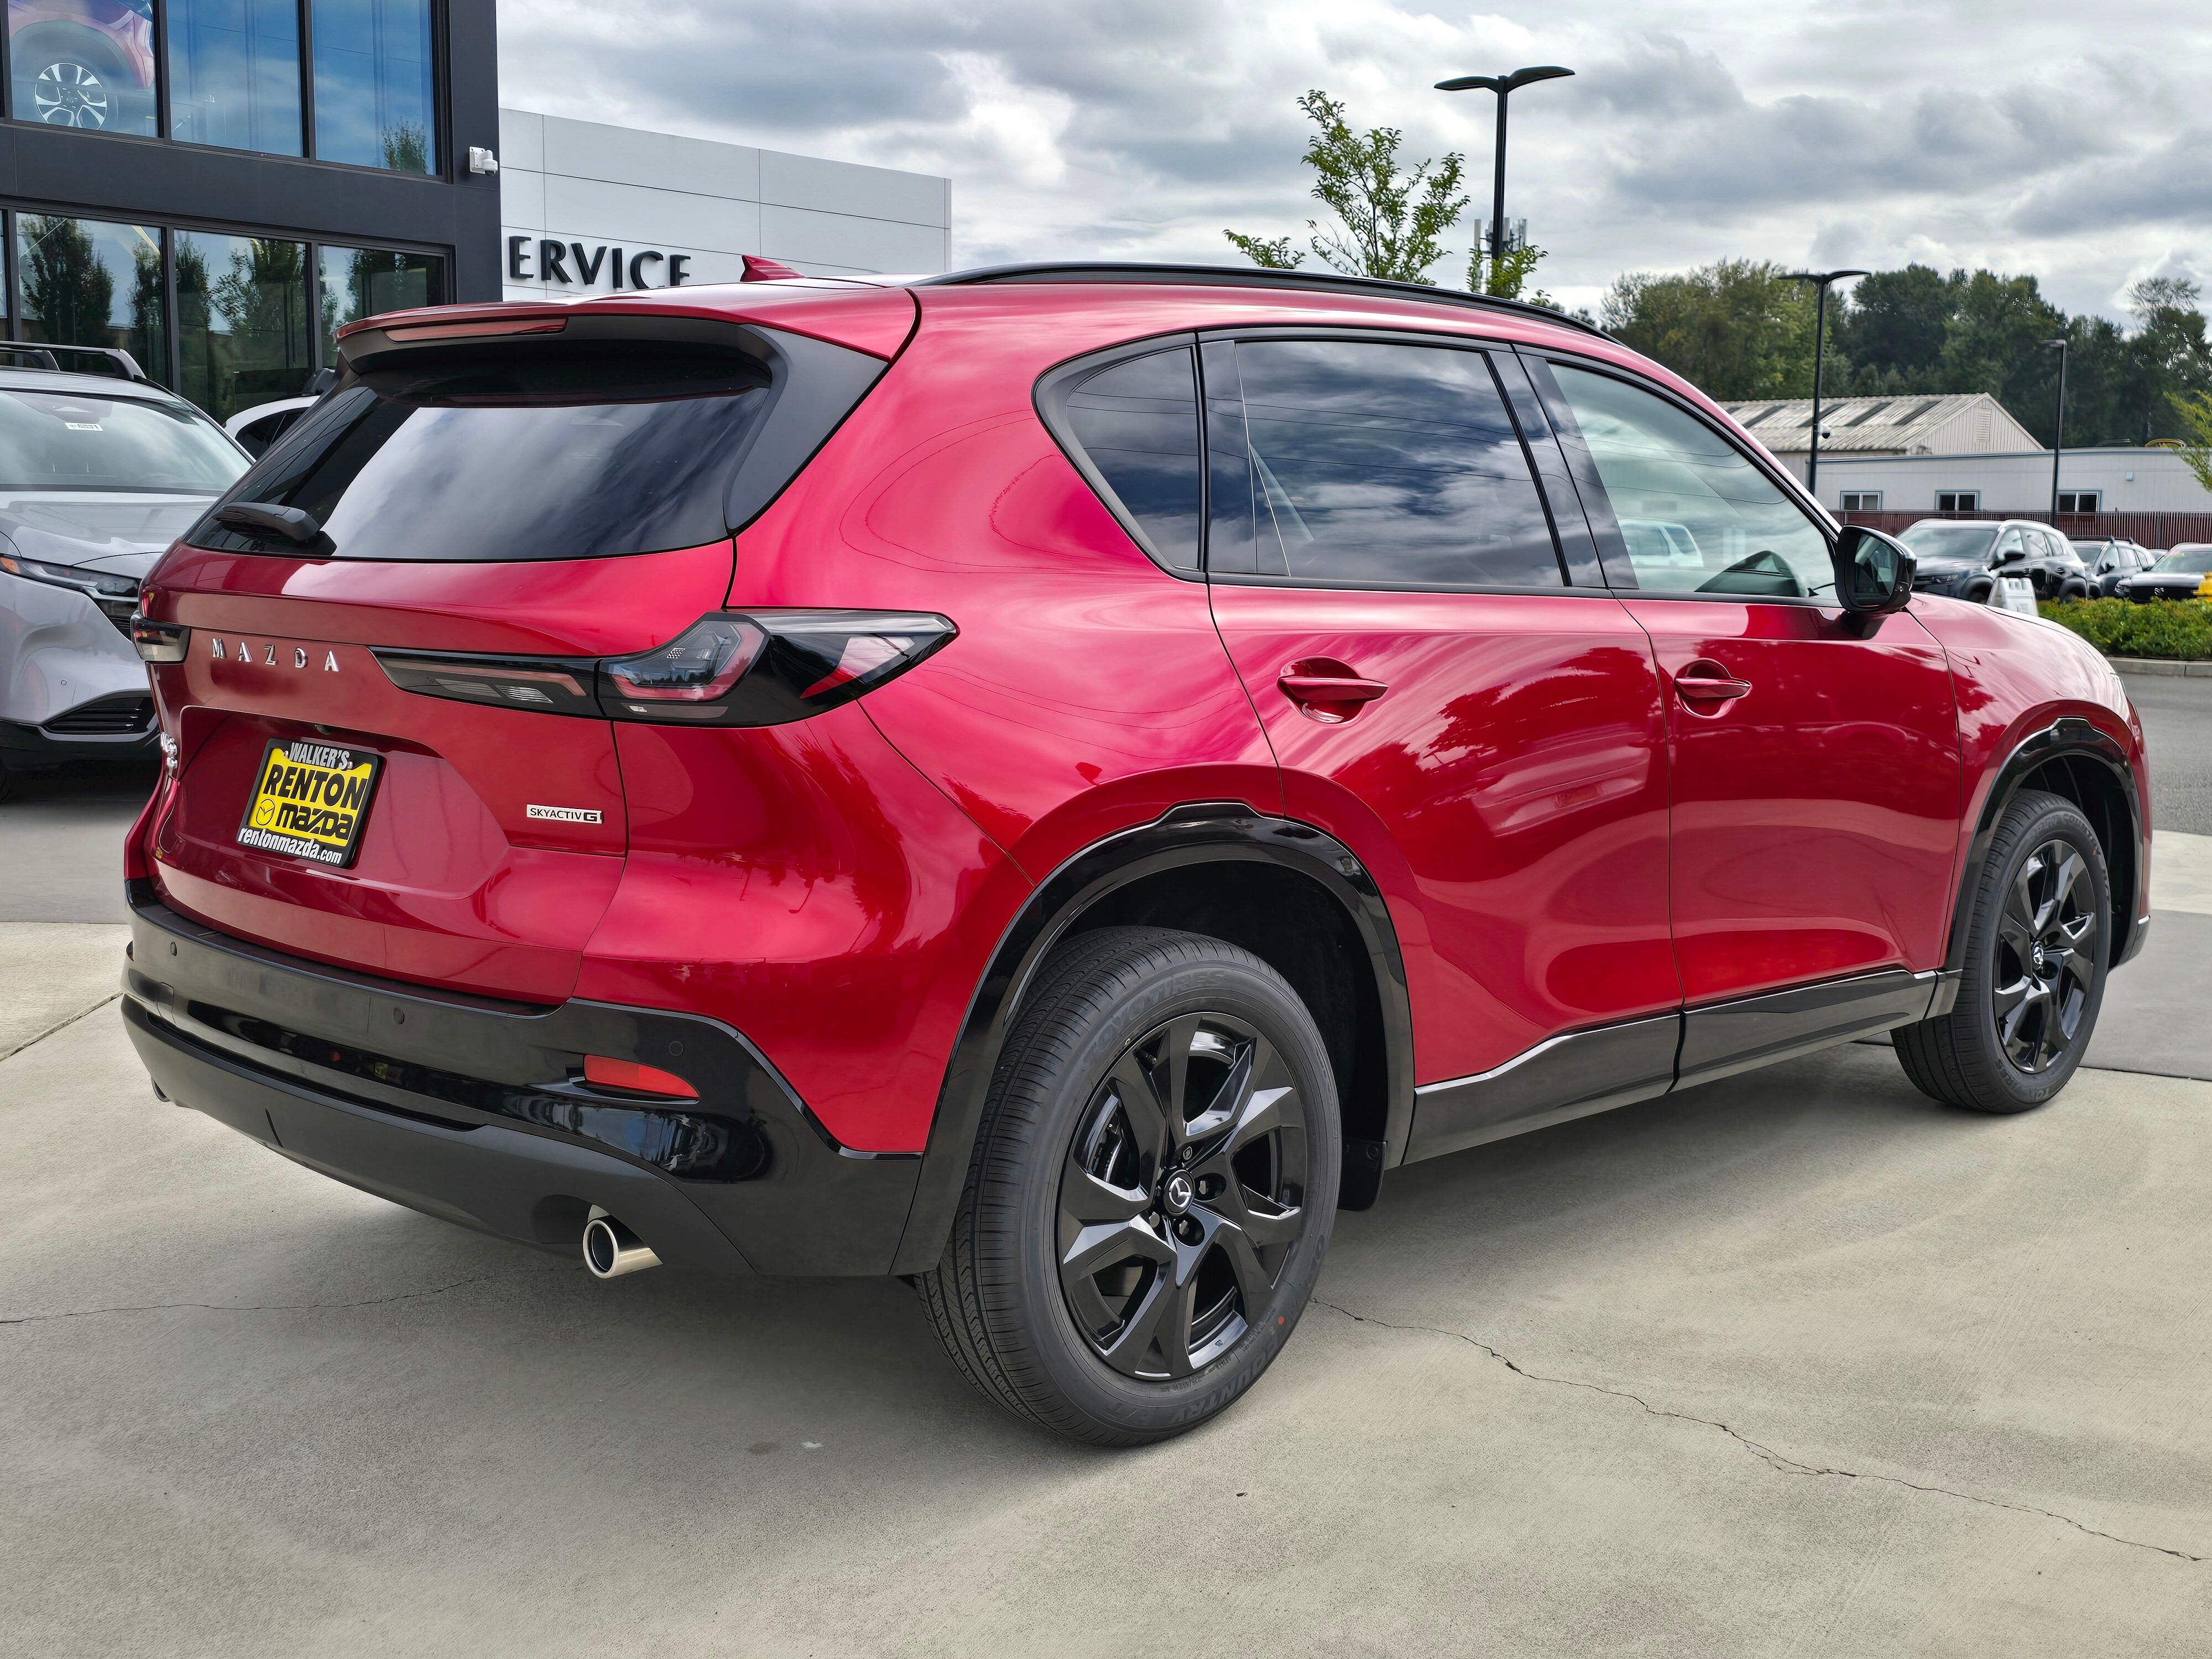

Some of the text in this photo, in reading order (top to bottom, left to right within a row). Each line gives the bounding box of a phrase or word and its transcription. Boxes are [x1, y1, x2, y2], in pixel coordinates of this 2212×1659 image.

[509, 235, 691, 289] ERVICE
[212, 638, 339, 672] MAZDA
[288, 742, 350, 770] WALKER'S
[263, 764, 367, 810] RENTON
[238, 827, 342, 864] rentonmazda.com
